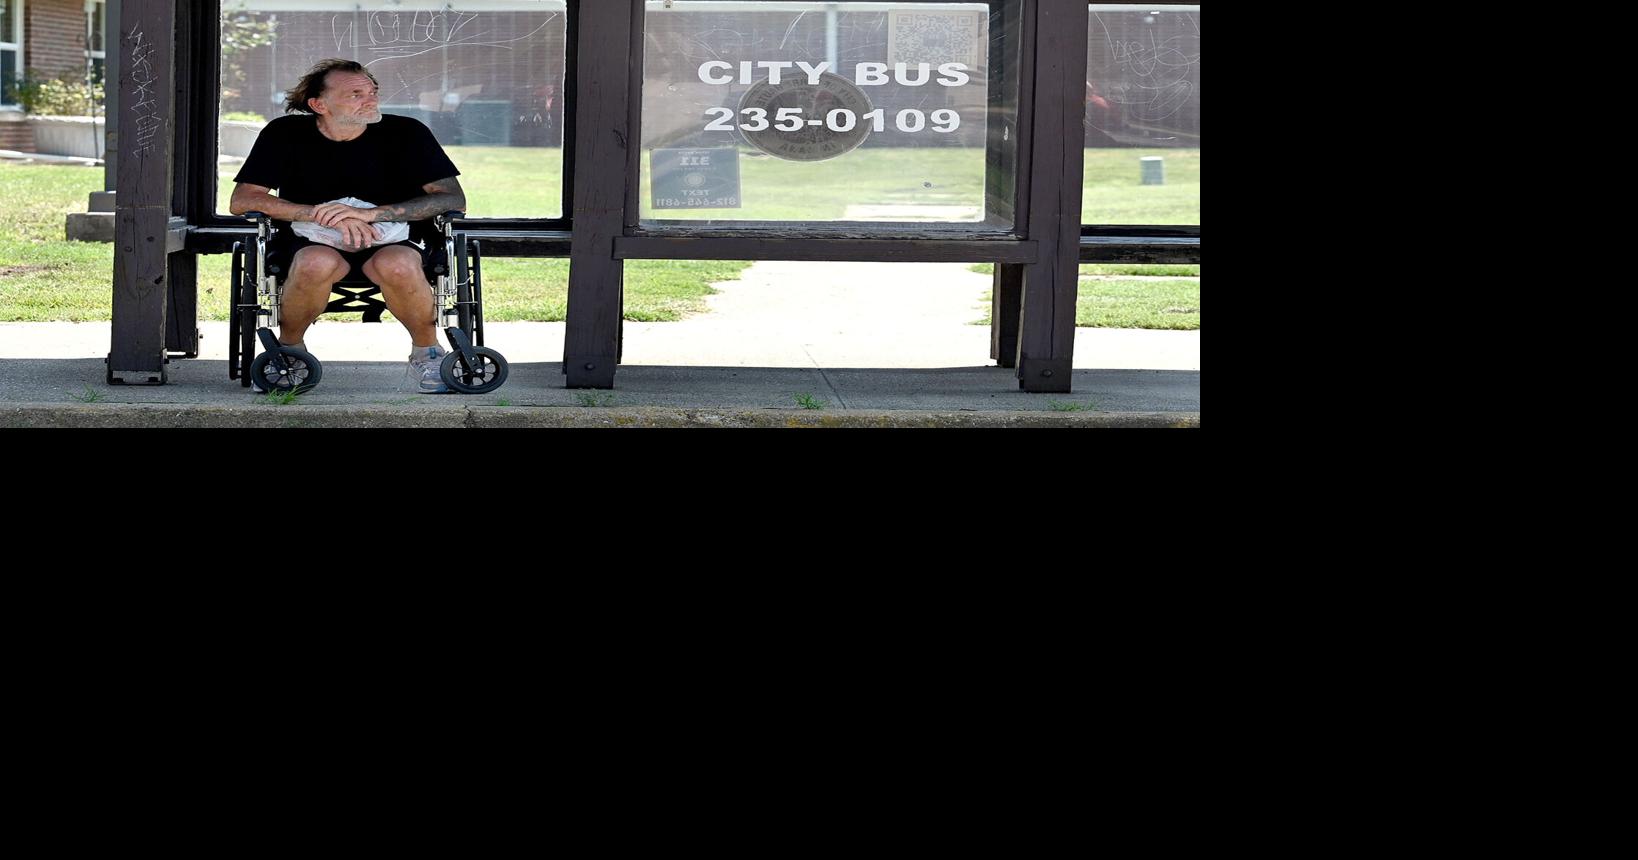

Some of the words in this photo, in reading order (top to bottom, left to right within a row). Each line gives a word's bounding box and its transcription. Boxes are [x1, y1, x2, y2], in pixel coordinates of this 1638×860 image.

[698, 60, 829, 86] CITY
[855, 61, 970, 86] BUS
[703, 107, 961, 133] 235-0109
